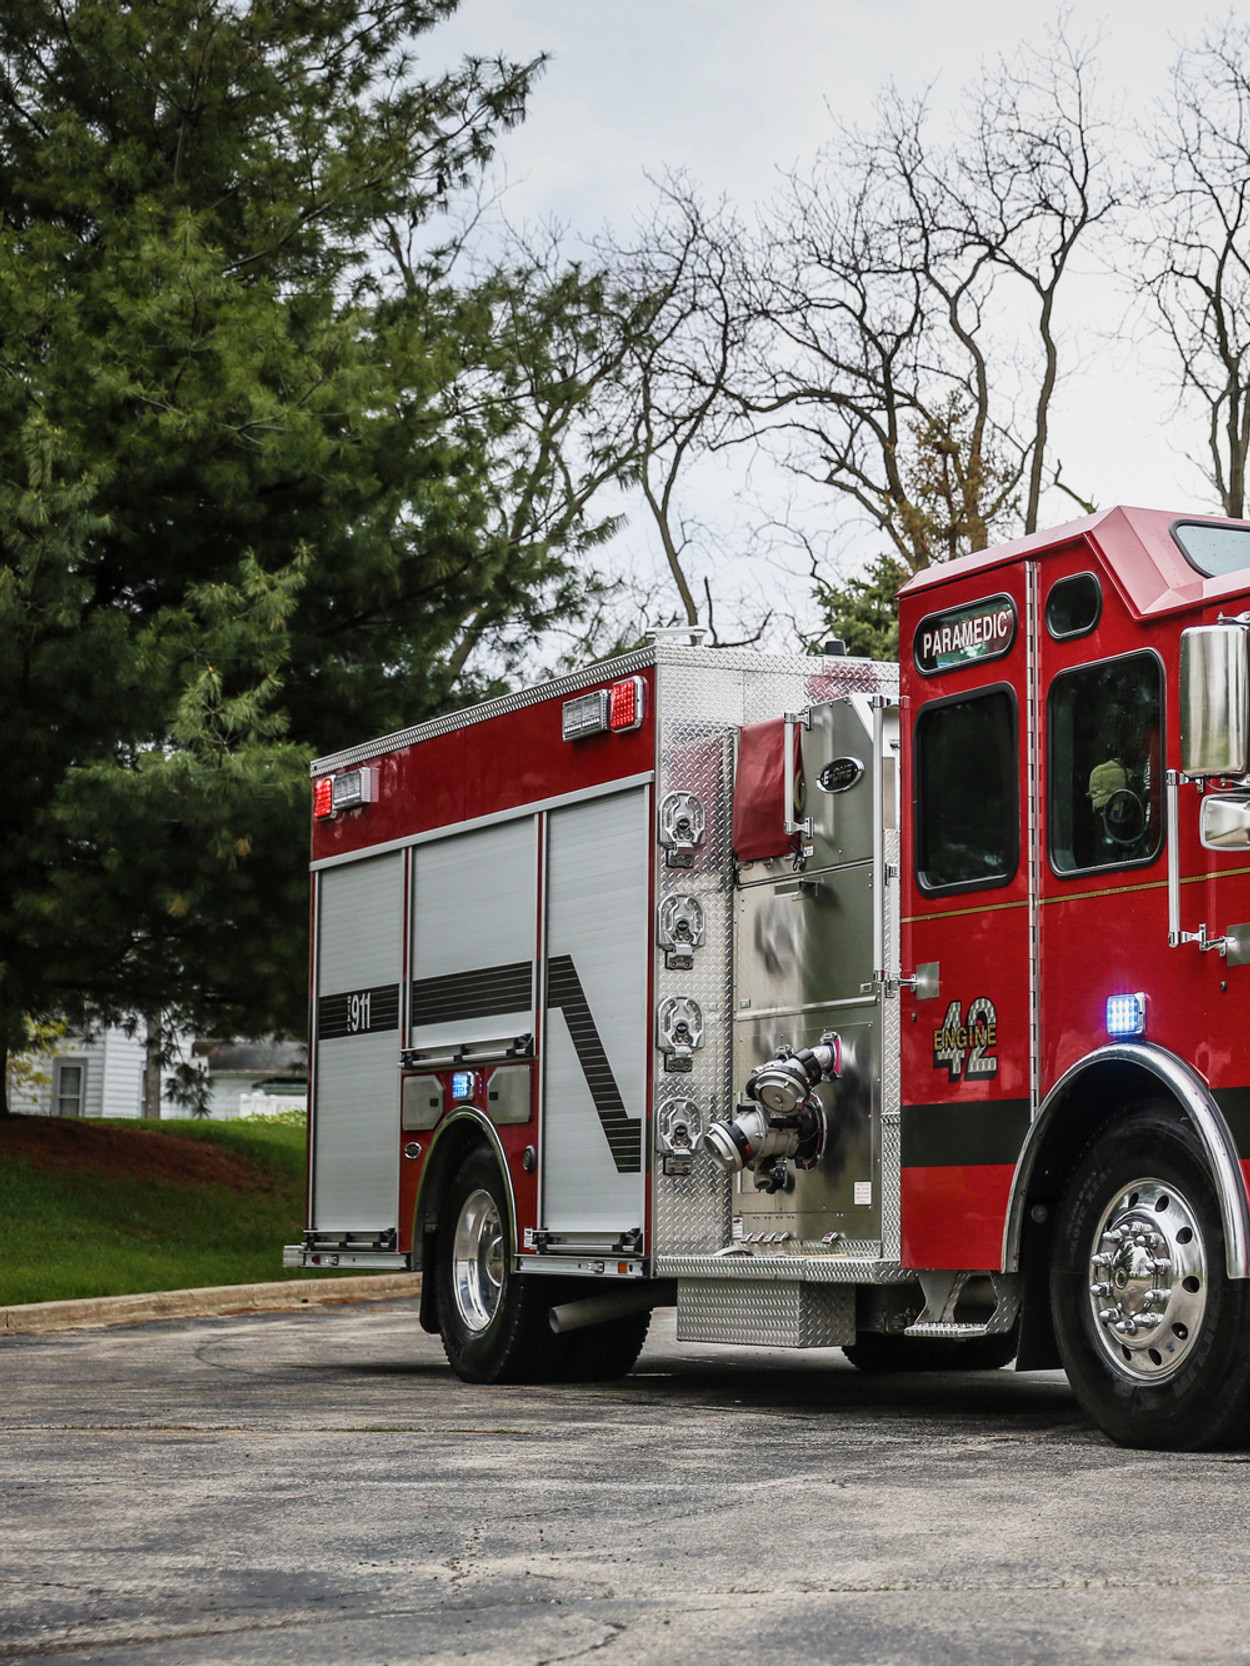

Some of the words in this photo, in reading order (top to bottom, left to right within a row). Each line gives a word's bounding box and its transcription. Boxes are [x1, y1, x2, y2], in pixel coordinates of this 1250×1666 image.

[922, 610, 1008, 659] PARAMEDIC
[352, 992, 371, 1032] 911
[933, 1024, 998, 1051] ENGINE
[934, 997, 998, 1081] 42
